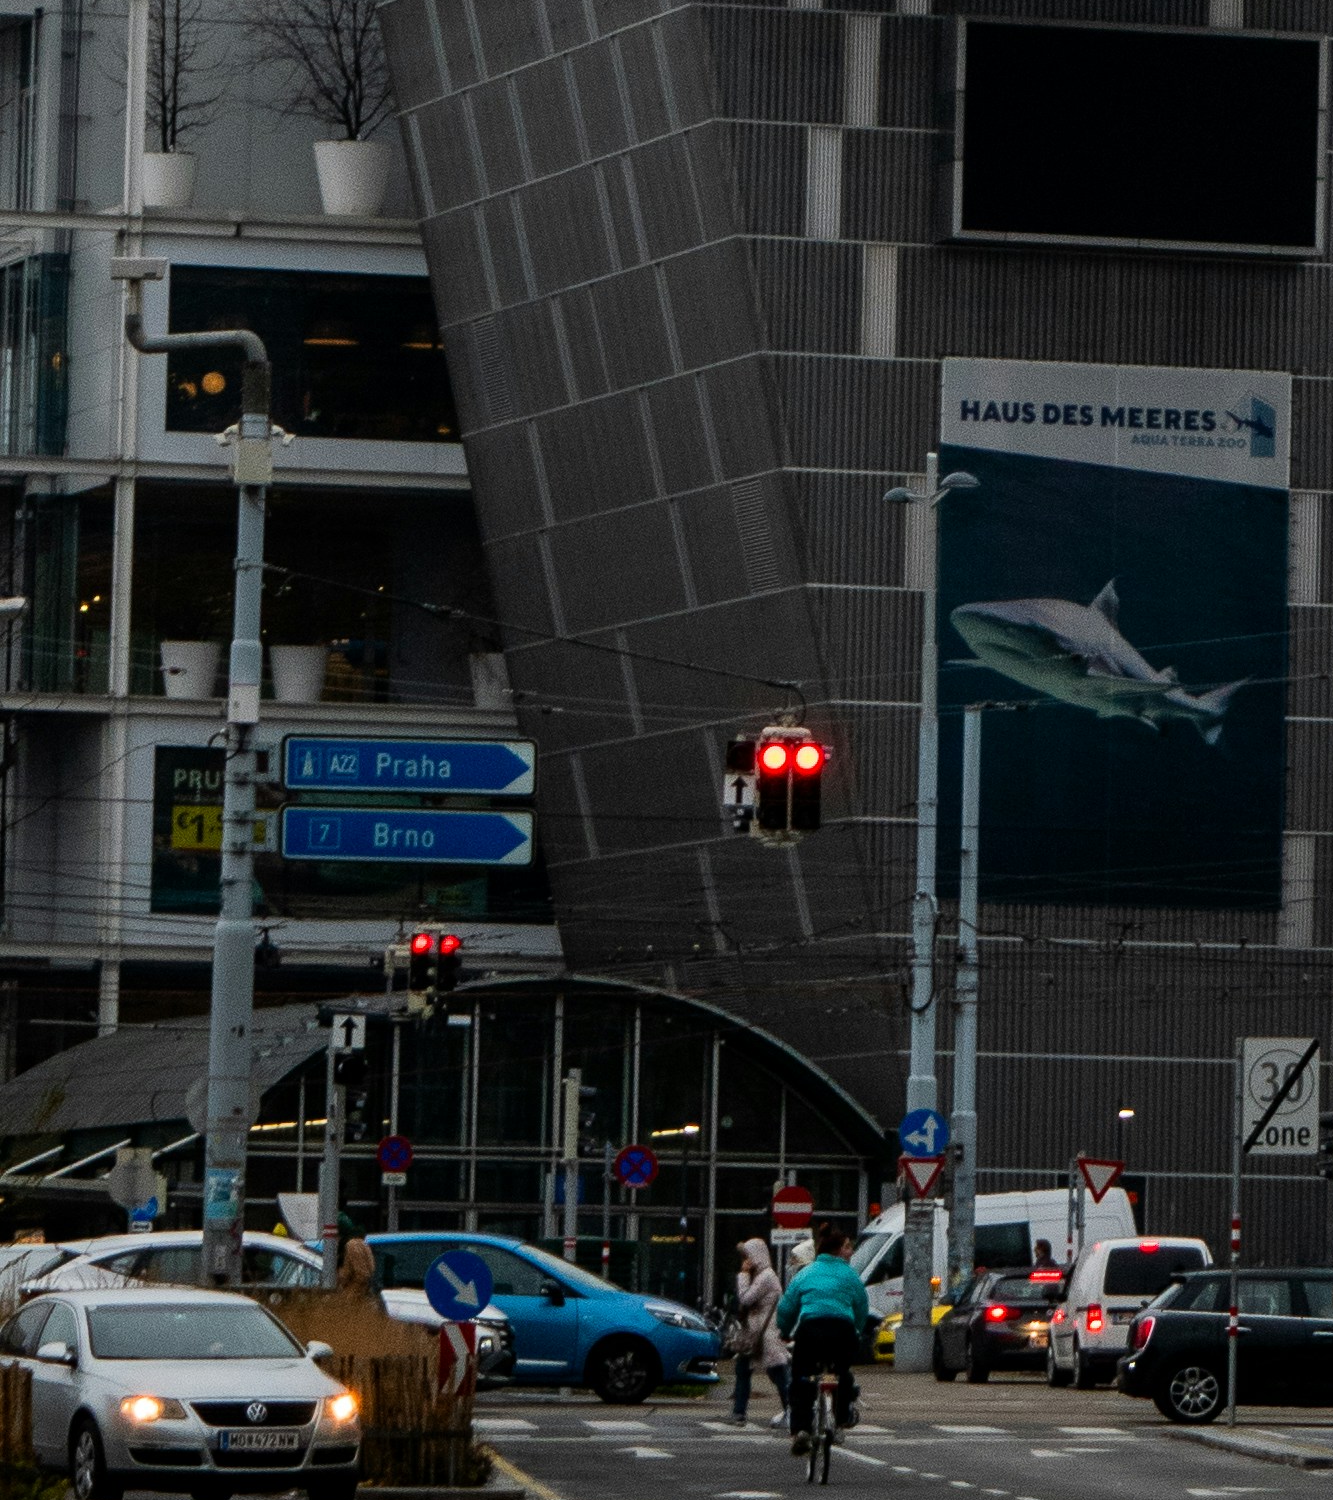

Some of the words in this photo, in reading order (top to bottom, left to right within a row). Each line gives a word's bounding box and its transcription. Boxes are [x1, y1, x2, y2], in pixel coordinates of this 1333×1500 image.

[960, 399, 1036, 425] HAUS
[1042, 403, 1094, 427] DES
[1101, 405, 1217, 433] MEERES
[1131, 434, 1169, 447] AQUA
[1217, 437, 1247, 449] ZOO
[328, 754, 356, 774] A22
[375, 752, 452, 778] Praha
[319, 824, 330, 842] 7
[373, 822, 435, 848] Brno
[1260, 1061, 1304, 1102] 30
[1252, 1120, 1310, 1146] Zone
